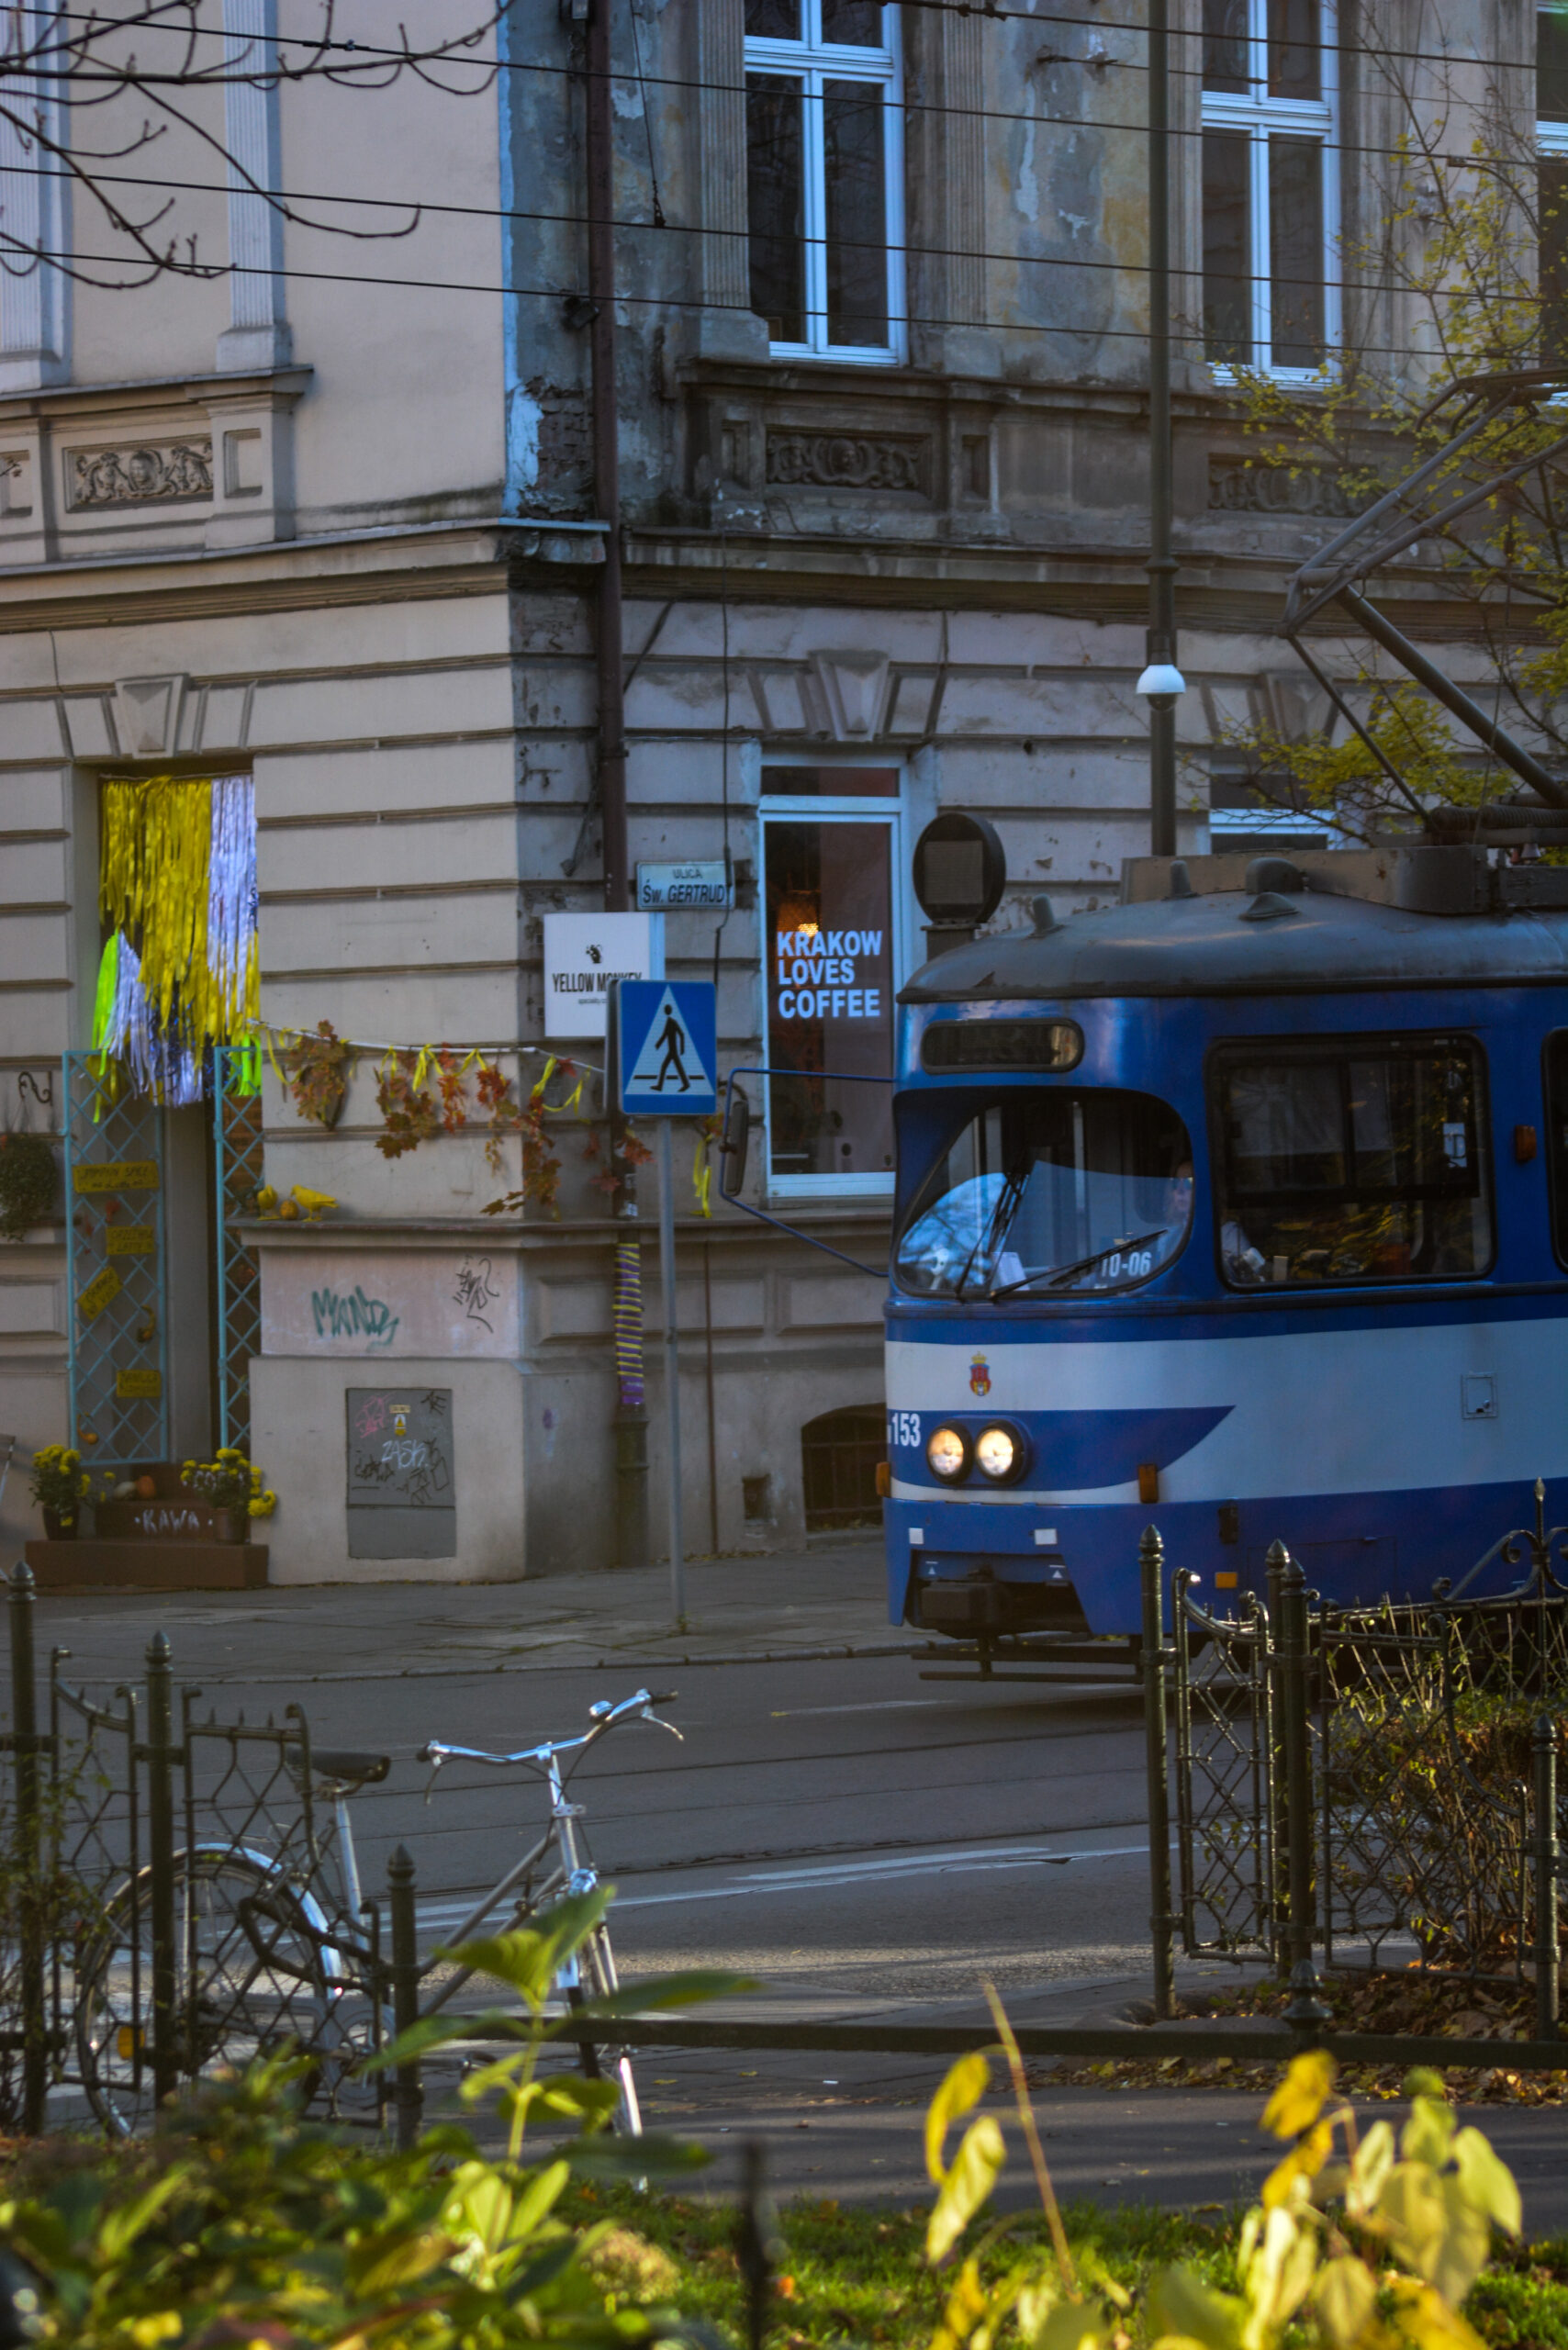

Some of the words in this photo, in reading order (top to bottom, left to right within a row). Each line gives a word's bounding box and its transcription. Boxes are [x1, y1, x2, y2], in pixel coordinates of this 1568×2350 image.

[672, 868, 703, 879] ULICA
[777, 930, 882, 957] KRAKOW
[552, 973, 595, 992] YELLOW
[778, 958, 856, 985] LOVES
[778, 989, 881, 1019] COFFEE
[1102, 1251, 1152, 1278] 10-06
[142, 1508, 200, 1535] KAWA
